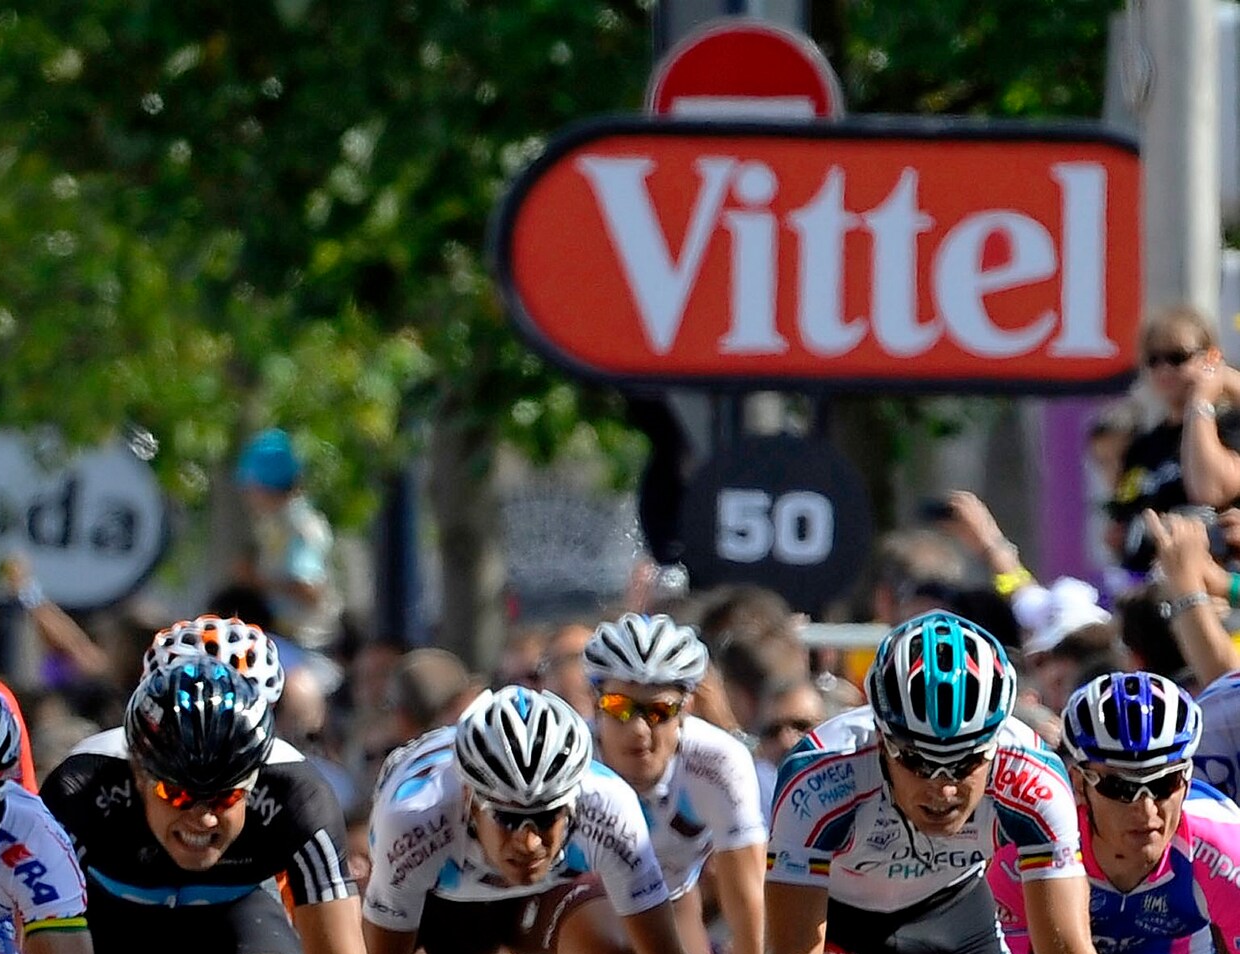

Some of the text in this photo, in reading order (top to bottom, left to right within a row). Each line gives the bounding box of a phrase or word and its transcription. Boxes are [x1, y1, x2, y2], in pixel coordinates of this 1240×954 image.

[577, 155, 1119, 359] Vittel
[714, 487, 836, 565] 50
[807, 762, 855, 792] OMEGA
